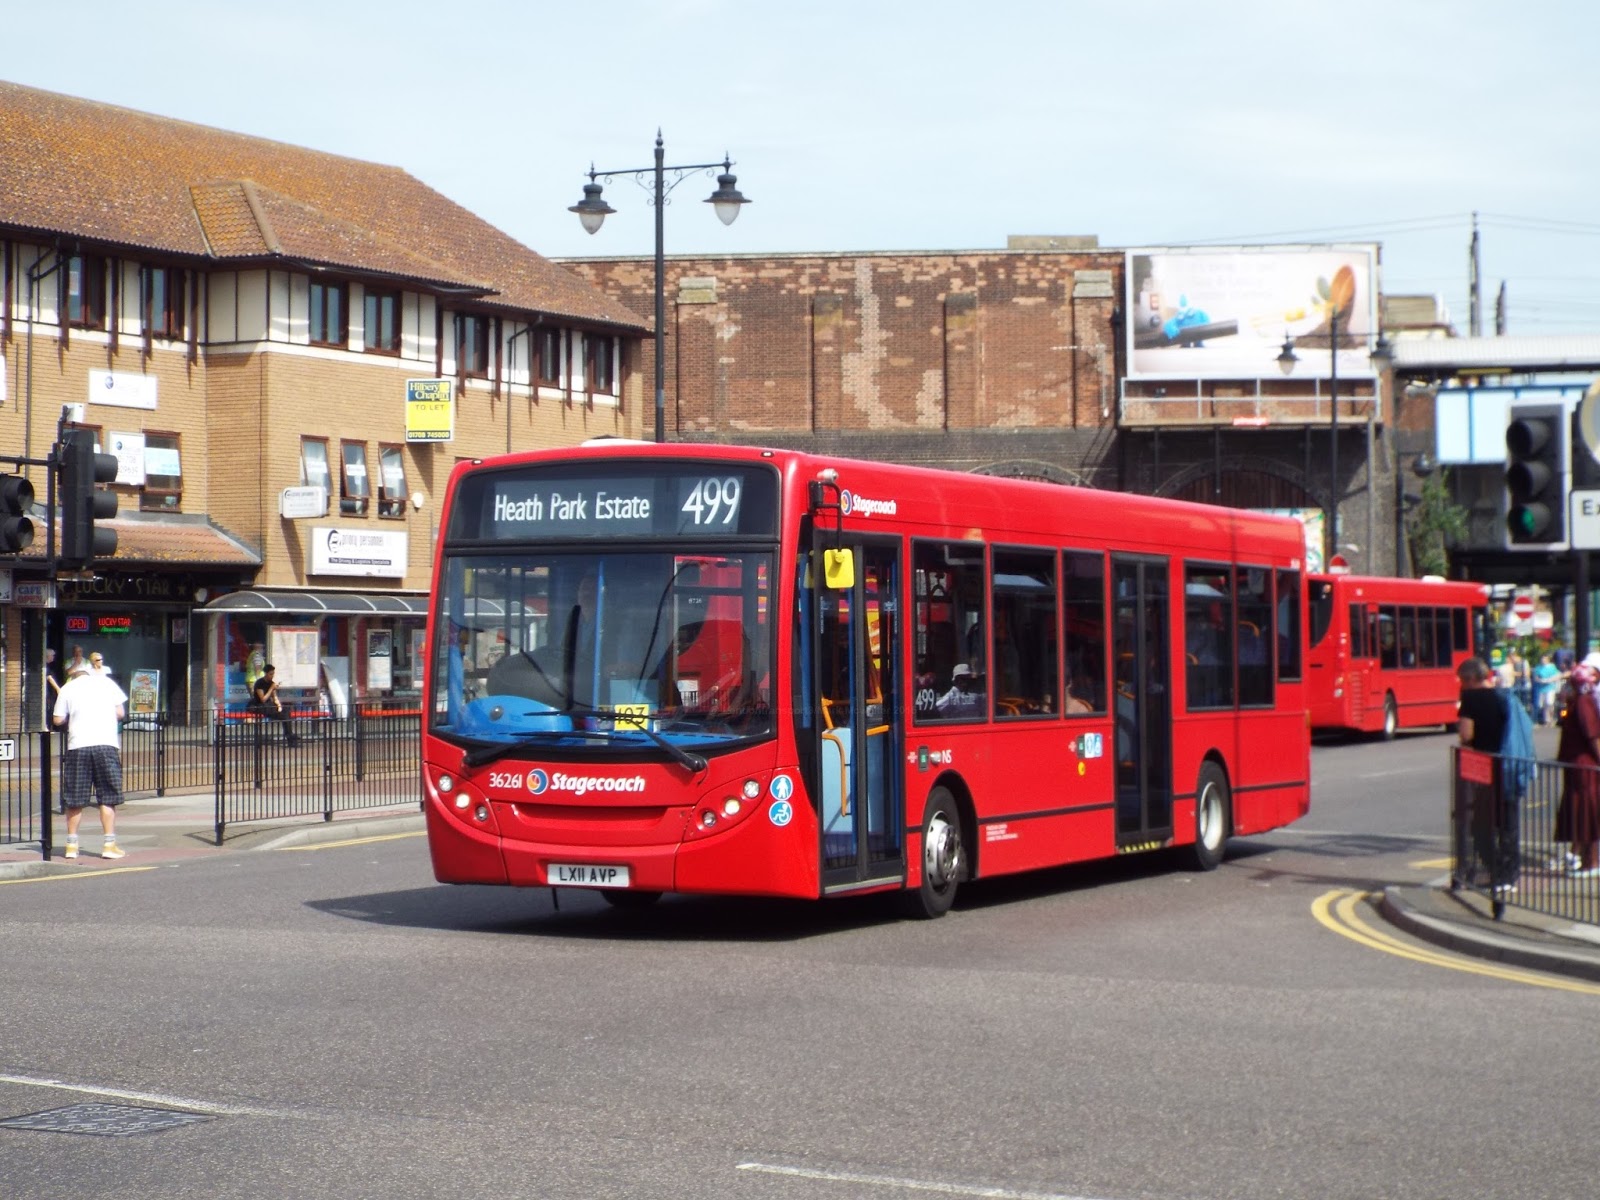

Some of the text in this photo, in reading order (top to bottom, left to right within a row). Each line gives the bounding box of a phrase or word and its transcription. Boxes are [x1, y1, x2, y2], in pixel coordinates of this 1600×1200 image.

[410, 382, 440, 393] Hilbery
[415, 391, 449, 401] Chaplin
[494, 477, 740, 524] Heath Park Estate 499
[852, 493, 897, 517] Stagecoach
[1582, 499, 1600, 516] E
[75, 576, 170, 596] LUCKY STAR
[68, 618, 87, 629] OPEN
[98, 618, 131, 627] LUCKY STAR
[915, 688, 935, 711] 499
[489, 772, 645, 795] 36261 Stagecoach
[559, 867, 617, 883] LX11 AVP
